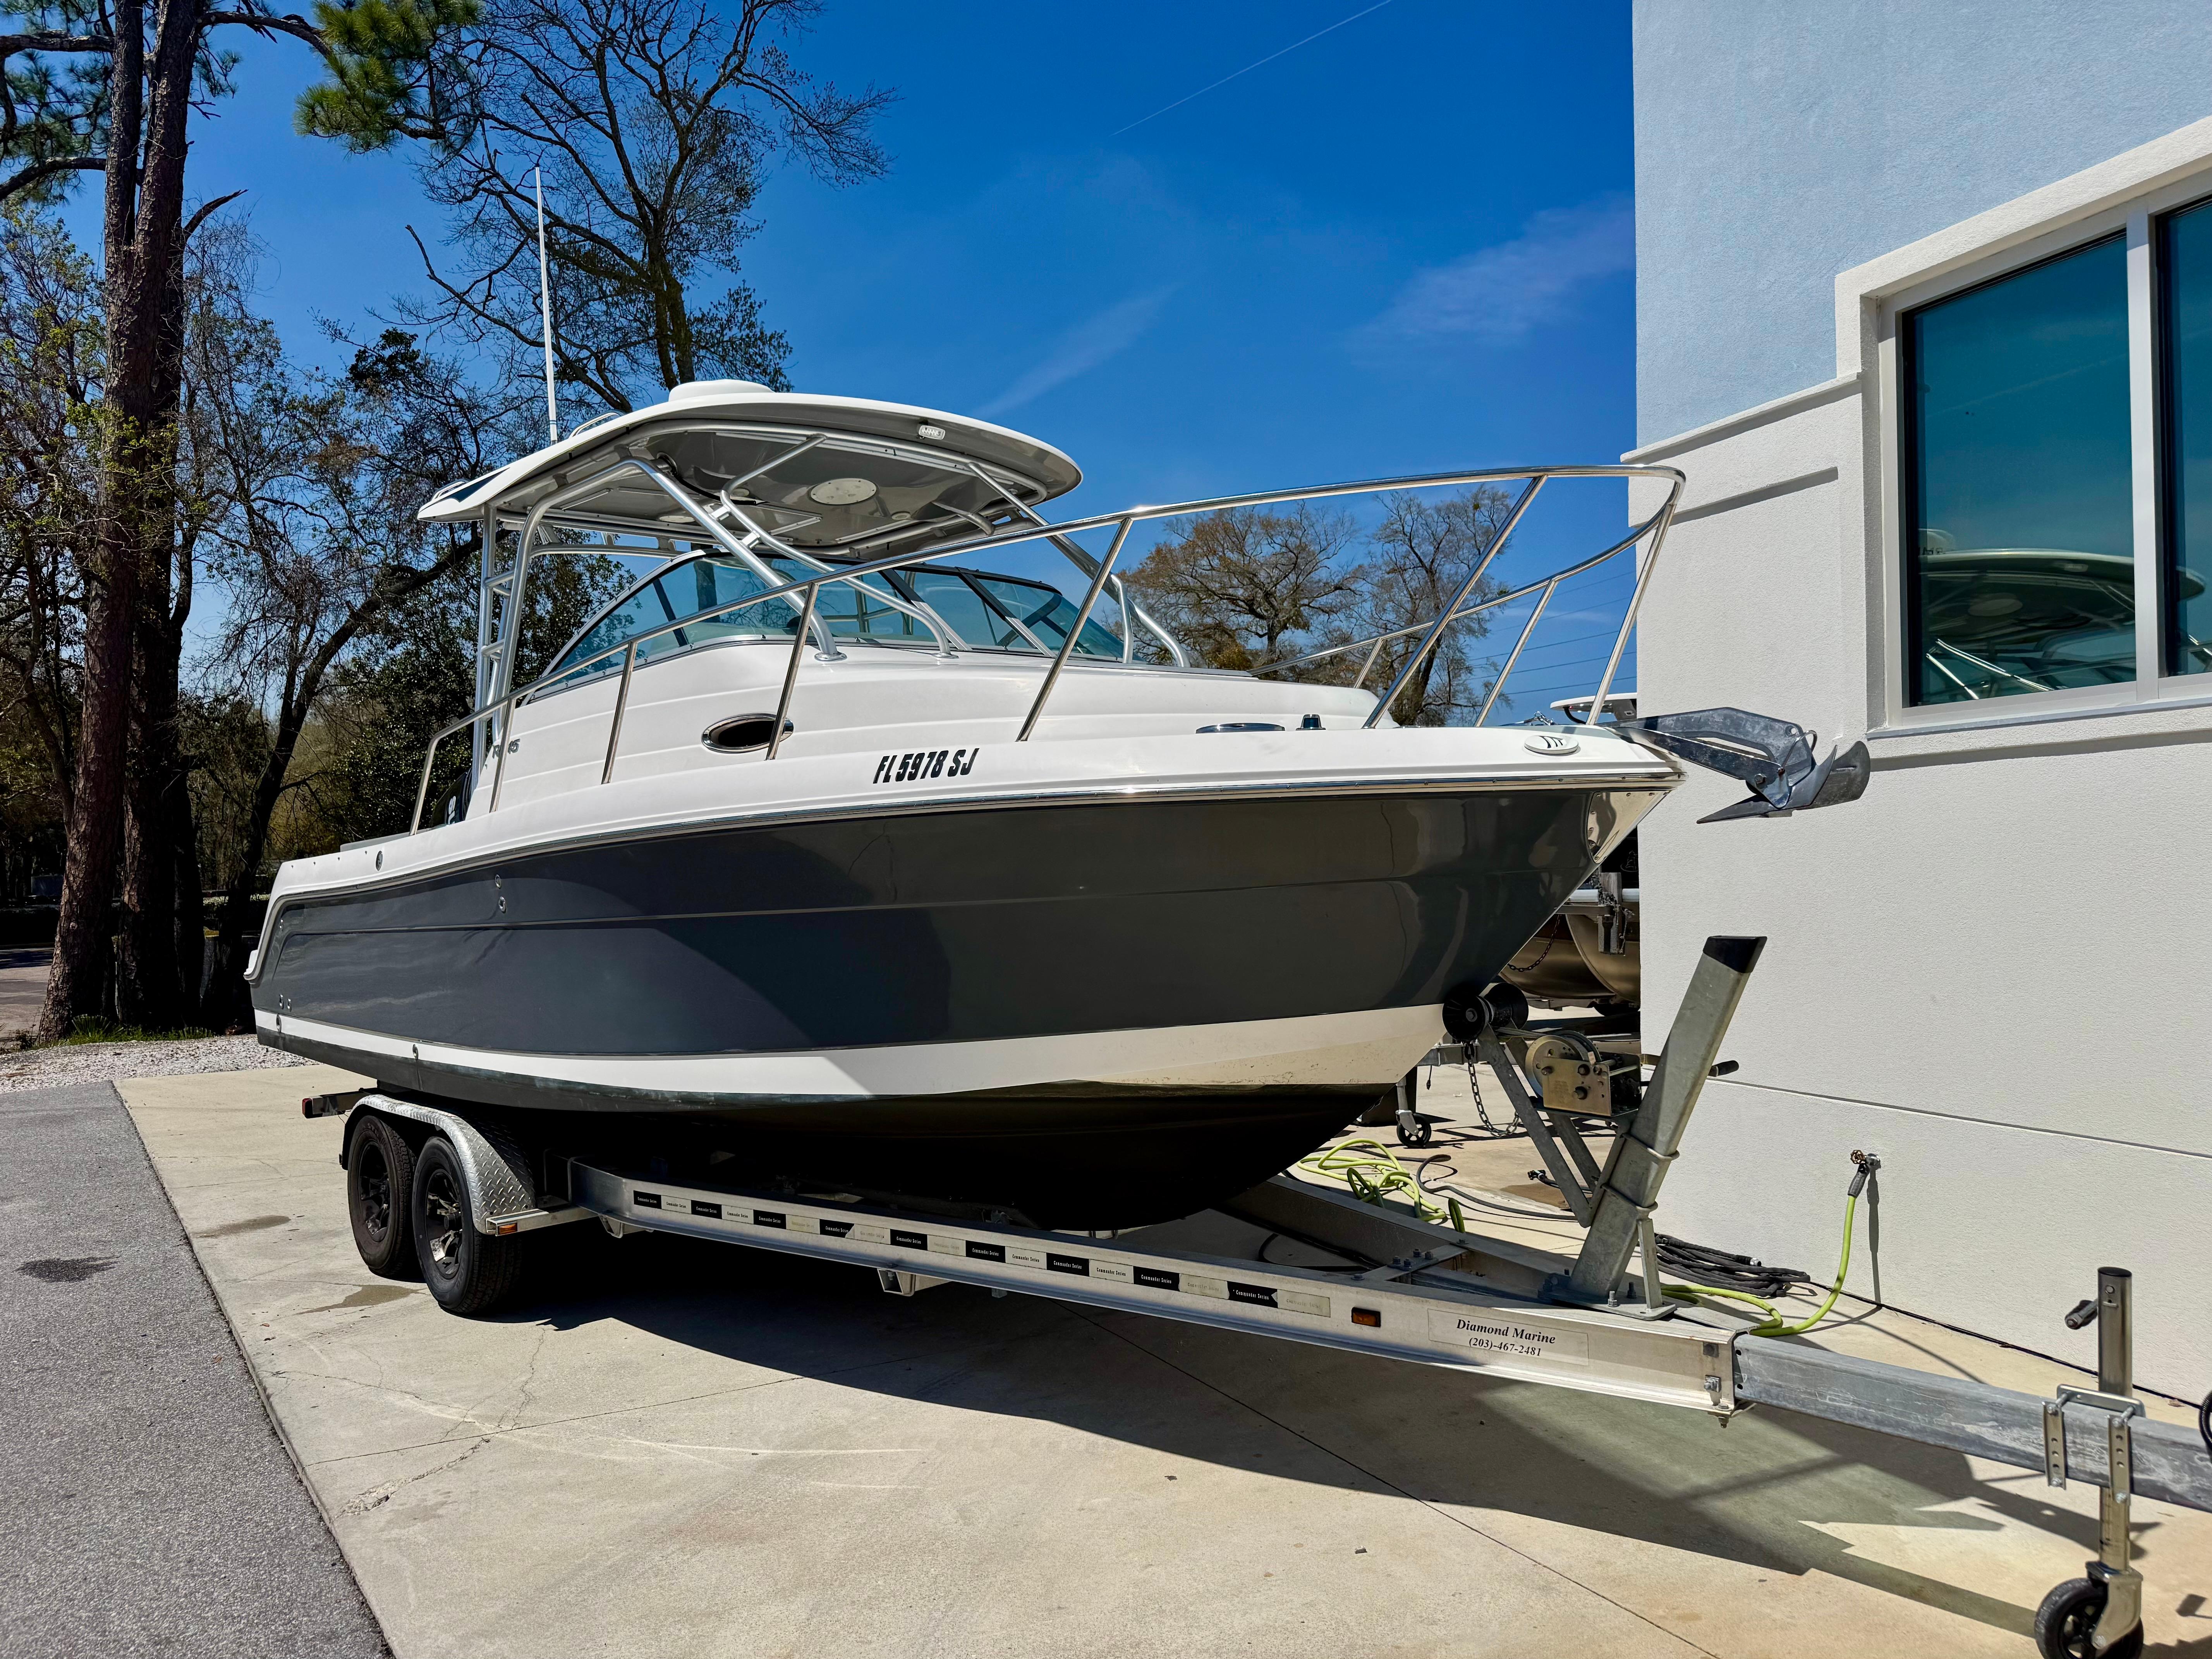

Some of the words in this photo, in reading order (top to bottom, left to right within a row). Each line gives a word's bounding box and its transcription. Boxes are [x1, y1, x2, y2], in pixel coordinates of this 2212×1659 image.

[872, 754, 898, 784] FL
[895, 750, 949, 782] 5978
[947, 748, 980, 777] SJ
[1456, 1319, 1509, 1336] Diamond
[1512, 1328, 1556, 1344] Marine
[1469, 1337, 1541, 1356] (203)-467-2481
